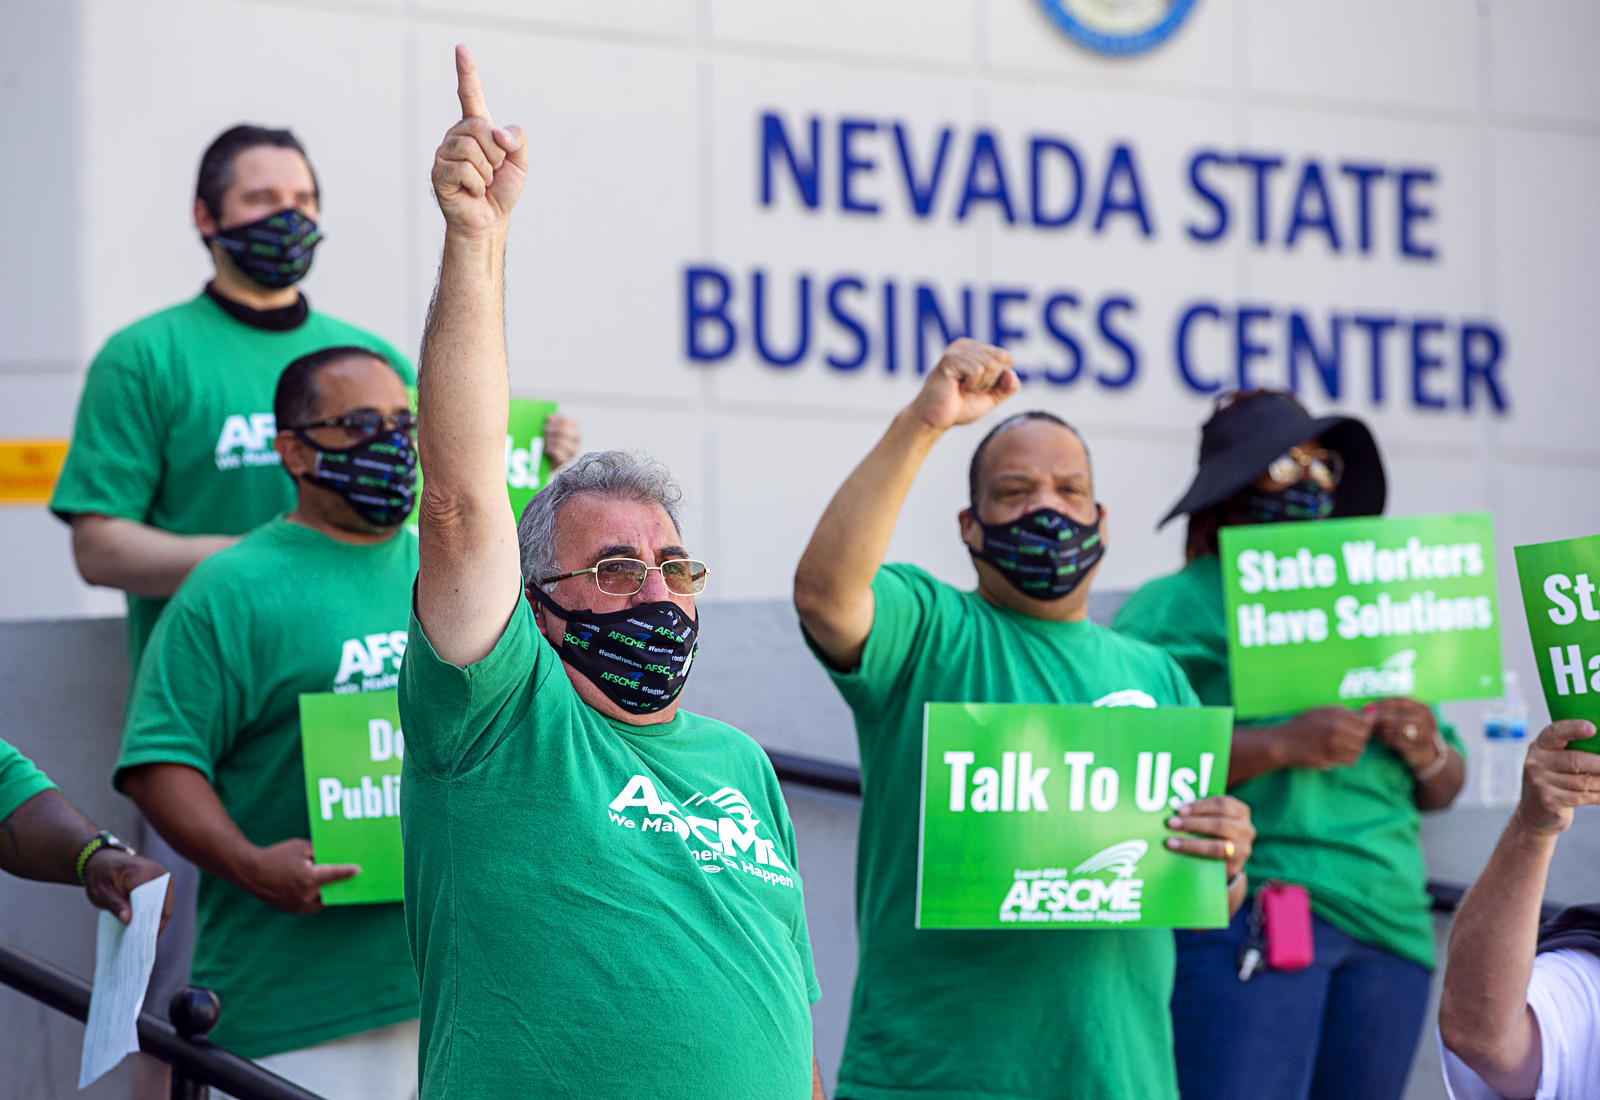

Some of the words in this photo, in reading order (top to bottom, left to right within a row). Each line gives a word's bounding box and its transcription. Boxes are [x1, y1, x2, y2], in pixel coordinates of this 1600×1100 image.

[757, 109, 1158, 239] NEVADA
[1184, 148, 1439, 261] STATE
[1174, 301, 1510, 415] CENTER
[1236, 548, 1337, 594] State
[1342, 538, 1484, 585] Workers
[1236, 603, 1330, 648] Have
[1334, 591, 1493, 639] Solutions
[1543, 573, 1600, 625] St
[608, 630, 647, 650] AFSCME
[600, 671, 641, 691] AFSCME
[943, 751, 1051, 813] Talk
[1064, 751, 1120, 813] To
[1135, 751, 1215, 813] Us!
[607, 808, 636, 829] We
[740, 860, 794, 889] Happen
[999, 878, 1144, 912] AFSCME
